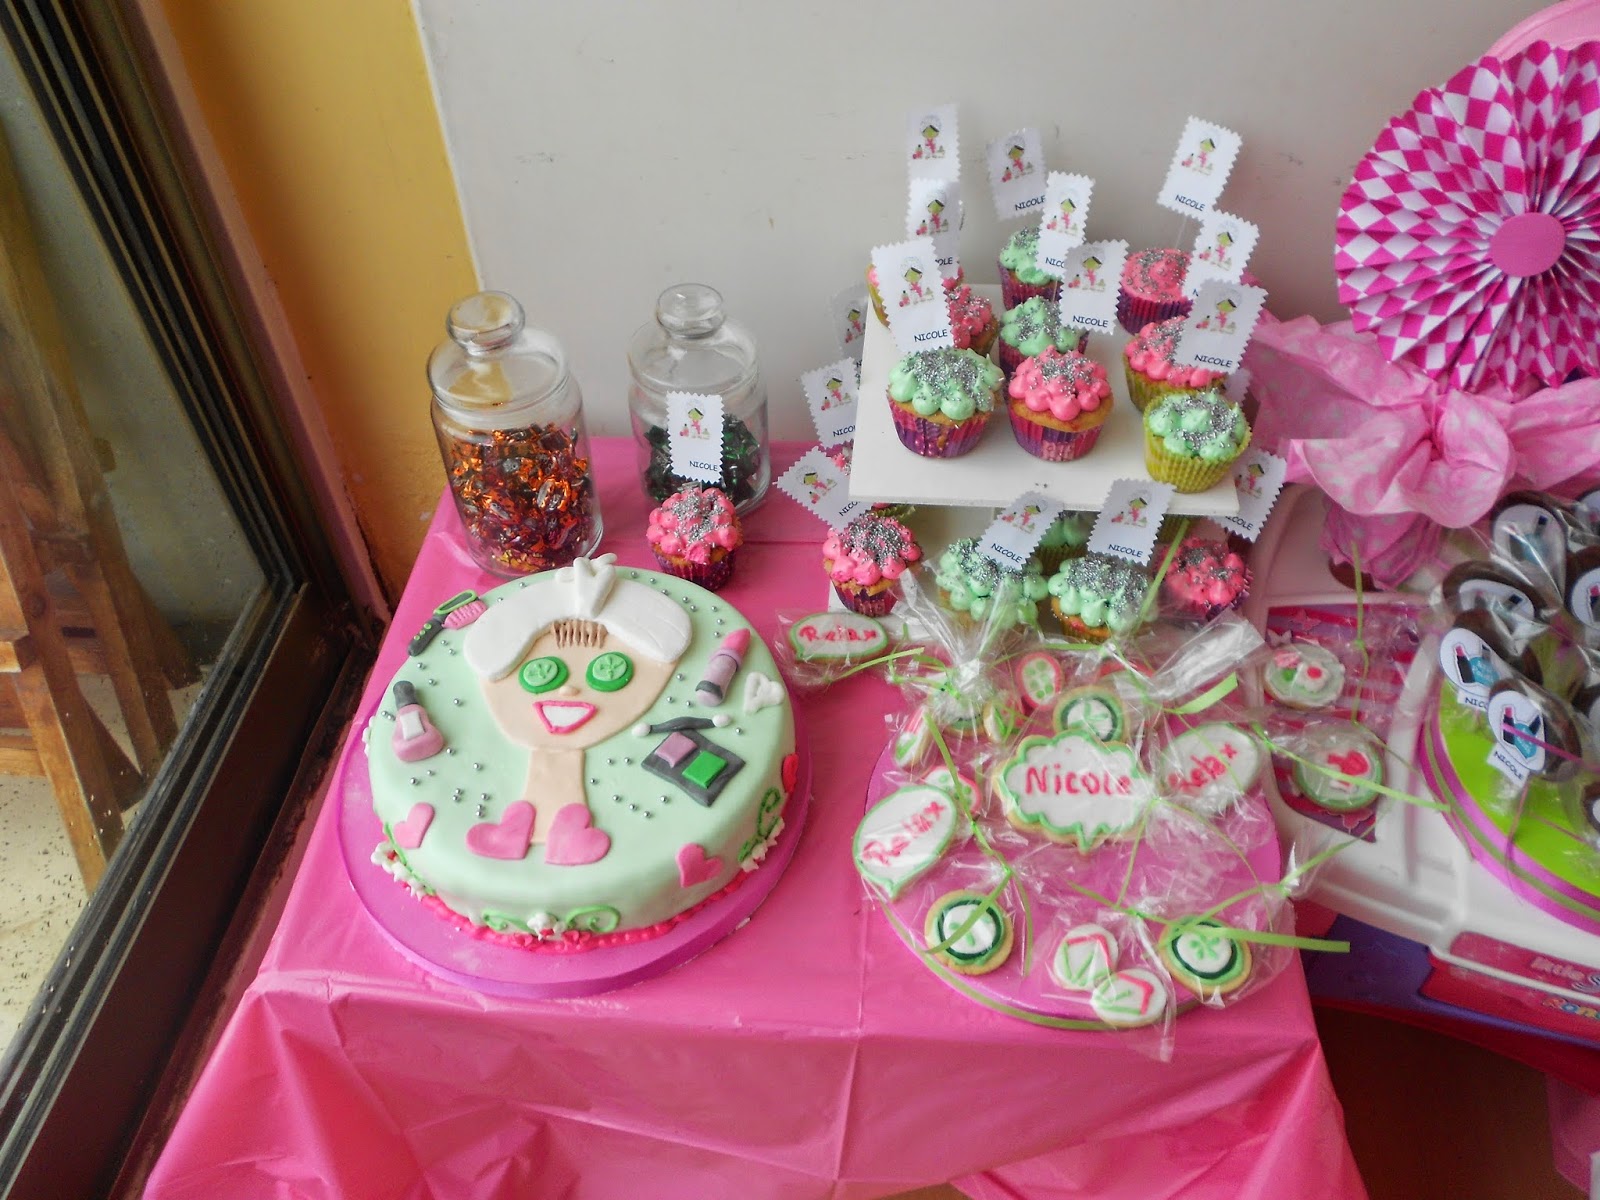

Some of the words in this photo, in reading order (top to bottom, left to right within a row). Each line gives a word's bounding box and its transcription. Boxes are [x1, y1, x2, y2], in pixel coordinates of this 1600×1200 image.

[1174, 193, 1205, 212] NICOLE
[1072, 315, 1109, 328] NICOLE
[913, 329, 948, 343] NICOLE
[1194, 353, 1233, 369] NICOLE
[832, 425, 856, 437] NICO
[689, 459, 719, 472] NICOLE
[839, 500, 859, 517] NICO
[1225, 515, 1254, 531] COLE
[990, 542, 1023, 564] NICOLE
[1107, 543, 1144, 559] NICOLE
[1493, 750, 1525, 781] NICOLE
[1024, 762, 1132, 796] Nicole
[861, 800, 946, 868] Relax
